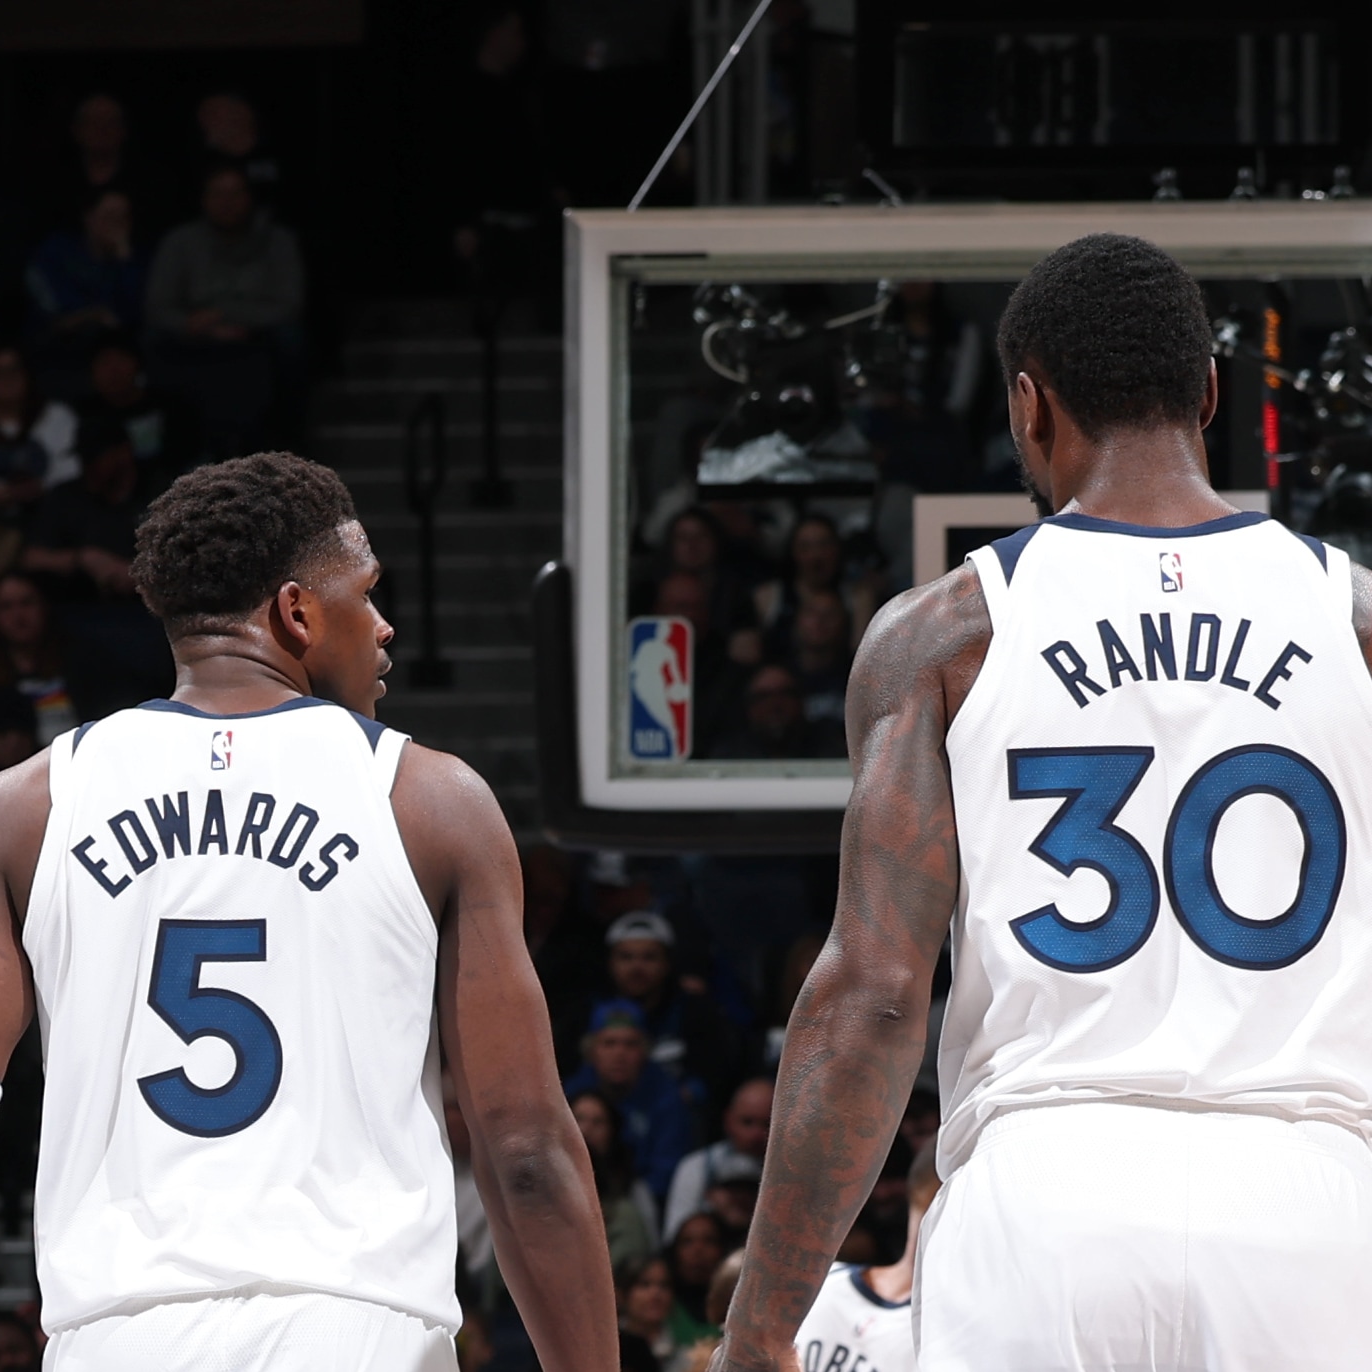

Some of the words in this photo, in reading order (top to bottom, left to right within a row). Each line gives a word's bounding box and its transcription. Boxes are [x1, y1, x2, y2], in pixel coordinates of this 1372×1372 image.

[1040, 612, 1313, 711] RANDLE
[70, 789, 360, 899] EDWARDS
[1007, 743, 1347, 974] 30
[137, 917, 283, 1139] 5
